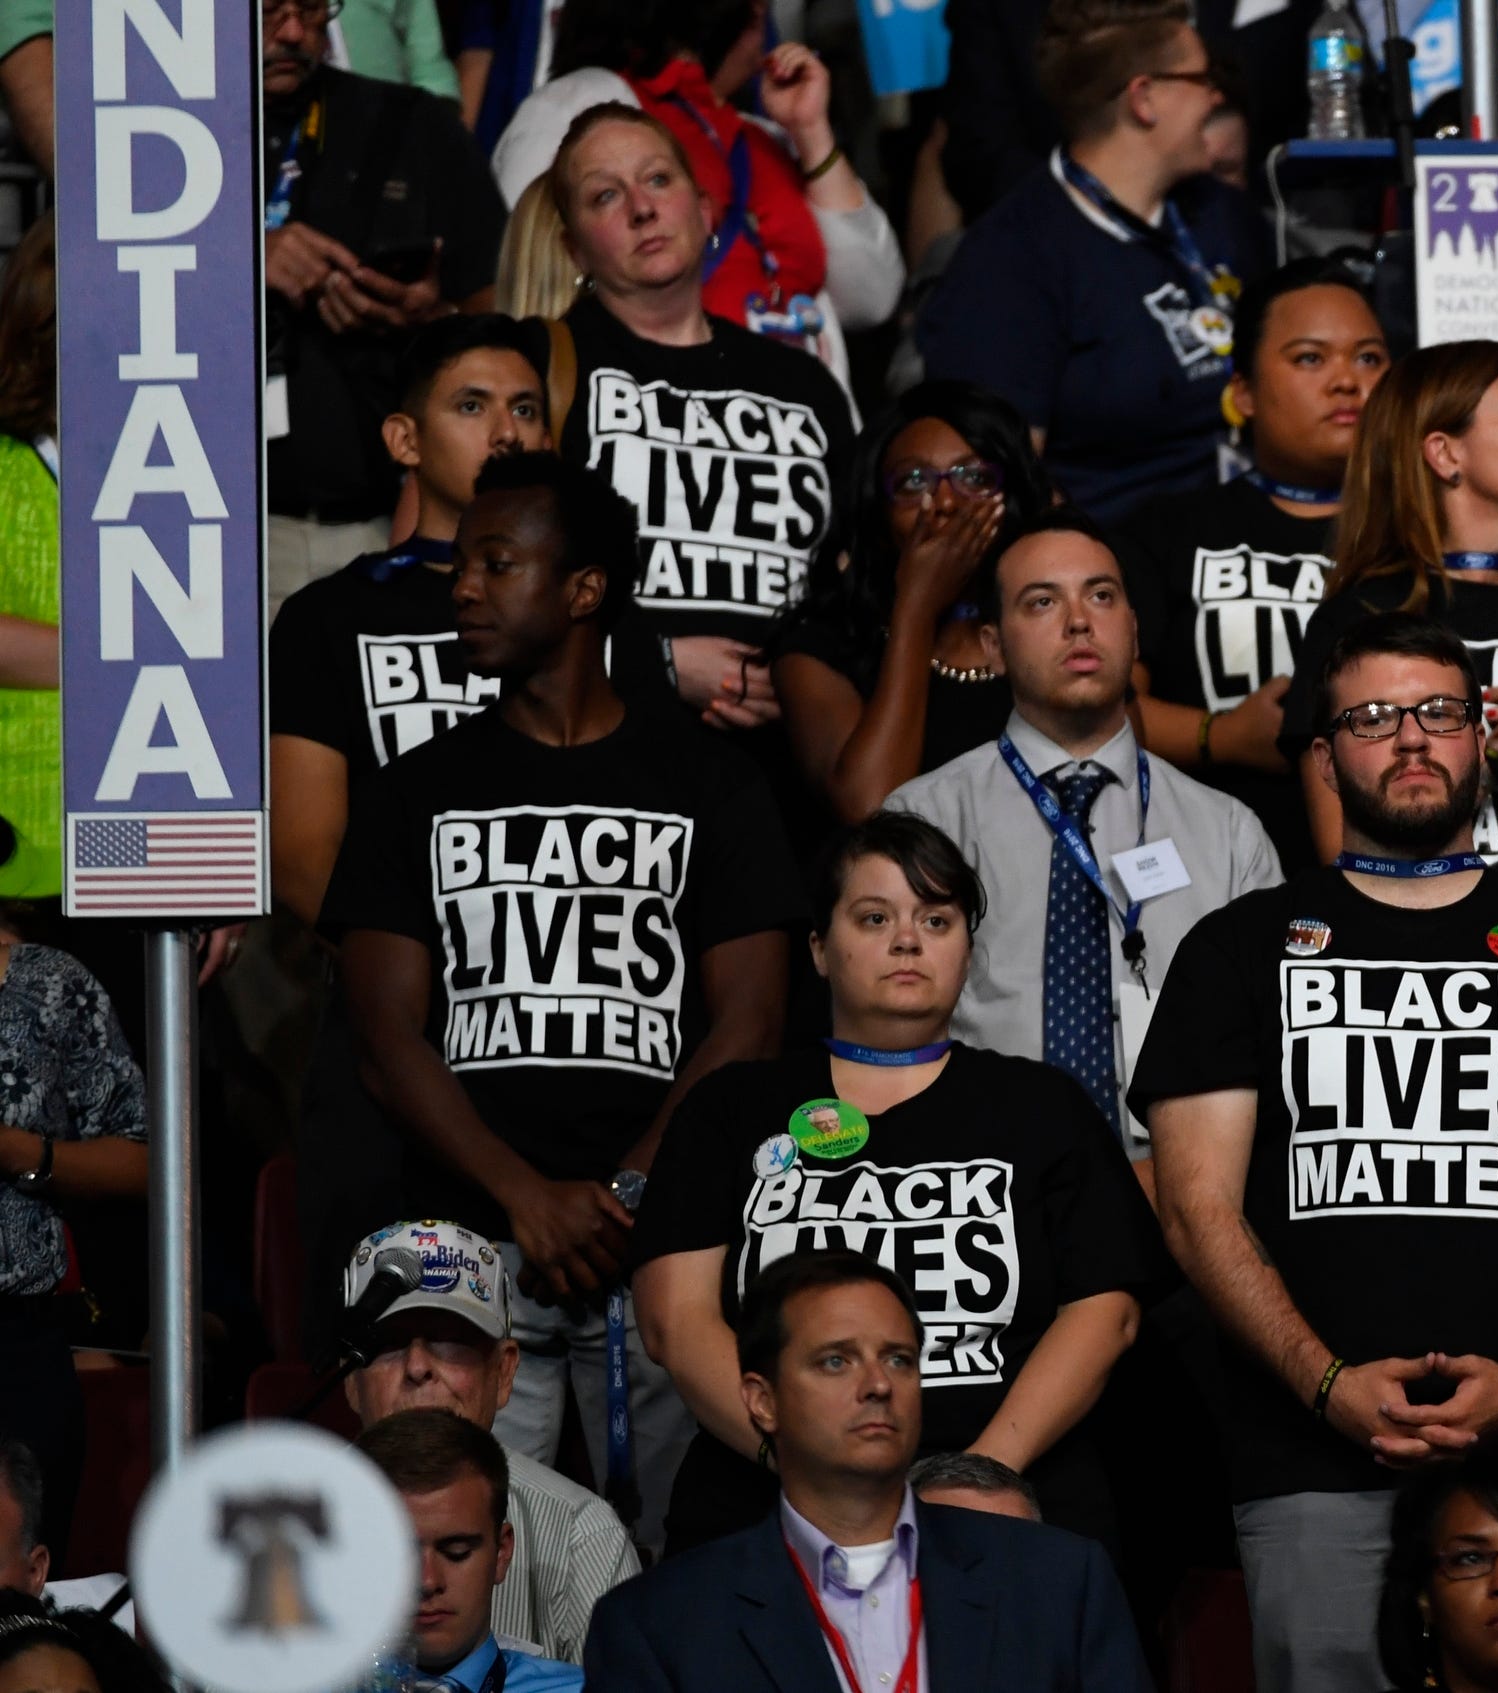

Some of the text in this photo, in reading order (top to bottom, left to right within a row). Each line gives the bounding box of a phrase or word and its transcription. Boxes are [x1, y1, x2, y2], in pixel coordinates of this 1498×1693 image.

[598, 375, 825, 459] BLACK
[1202, 555, 1326, 602] BLA
[438, 817, 684, 895] BLACK
[1355, 858, 1396, 873] DNC 2016
[1421, 862, 1445, 874] Ford
[444, 891, 677, 998] LIVES
[449, 996, 672, 1069] MATTER
[800, 1125, 867, 1148] DELEGATE
[813, 1136, 861, 1152] Sanders
[751, 1166, 1002, 1226] BLACK
[613, 1345, 623, 1388] DNC 2016
